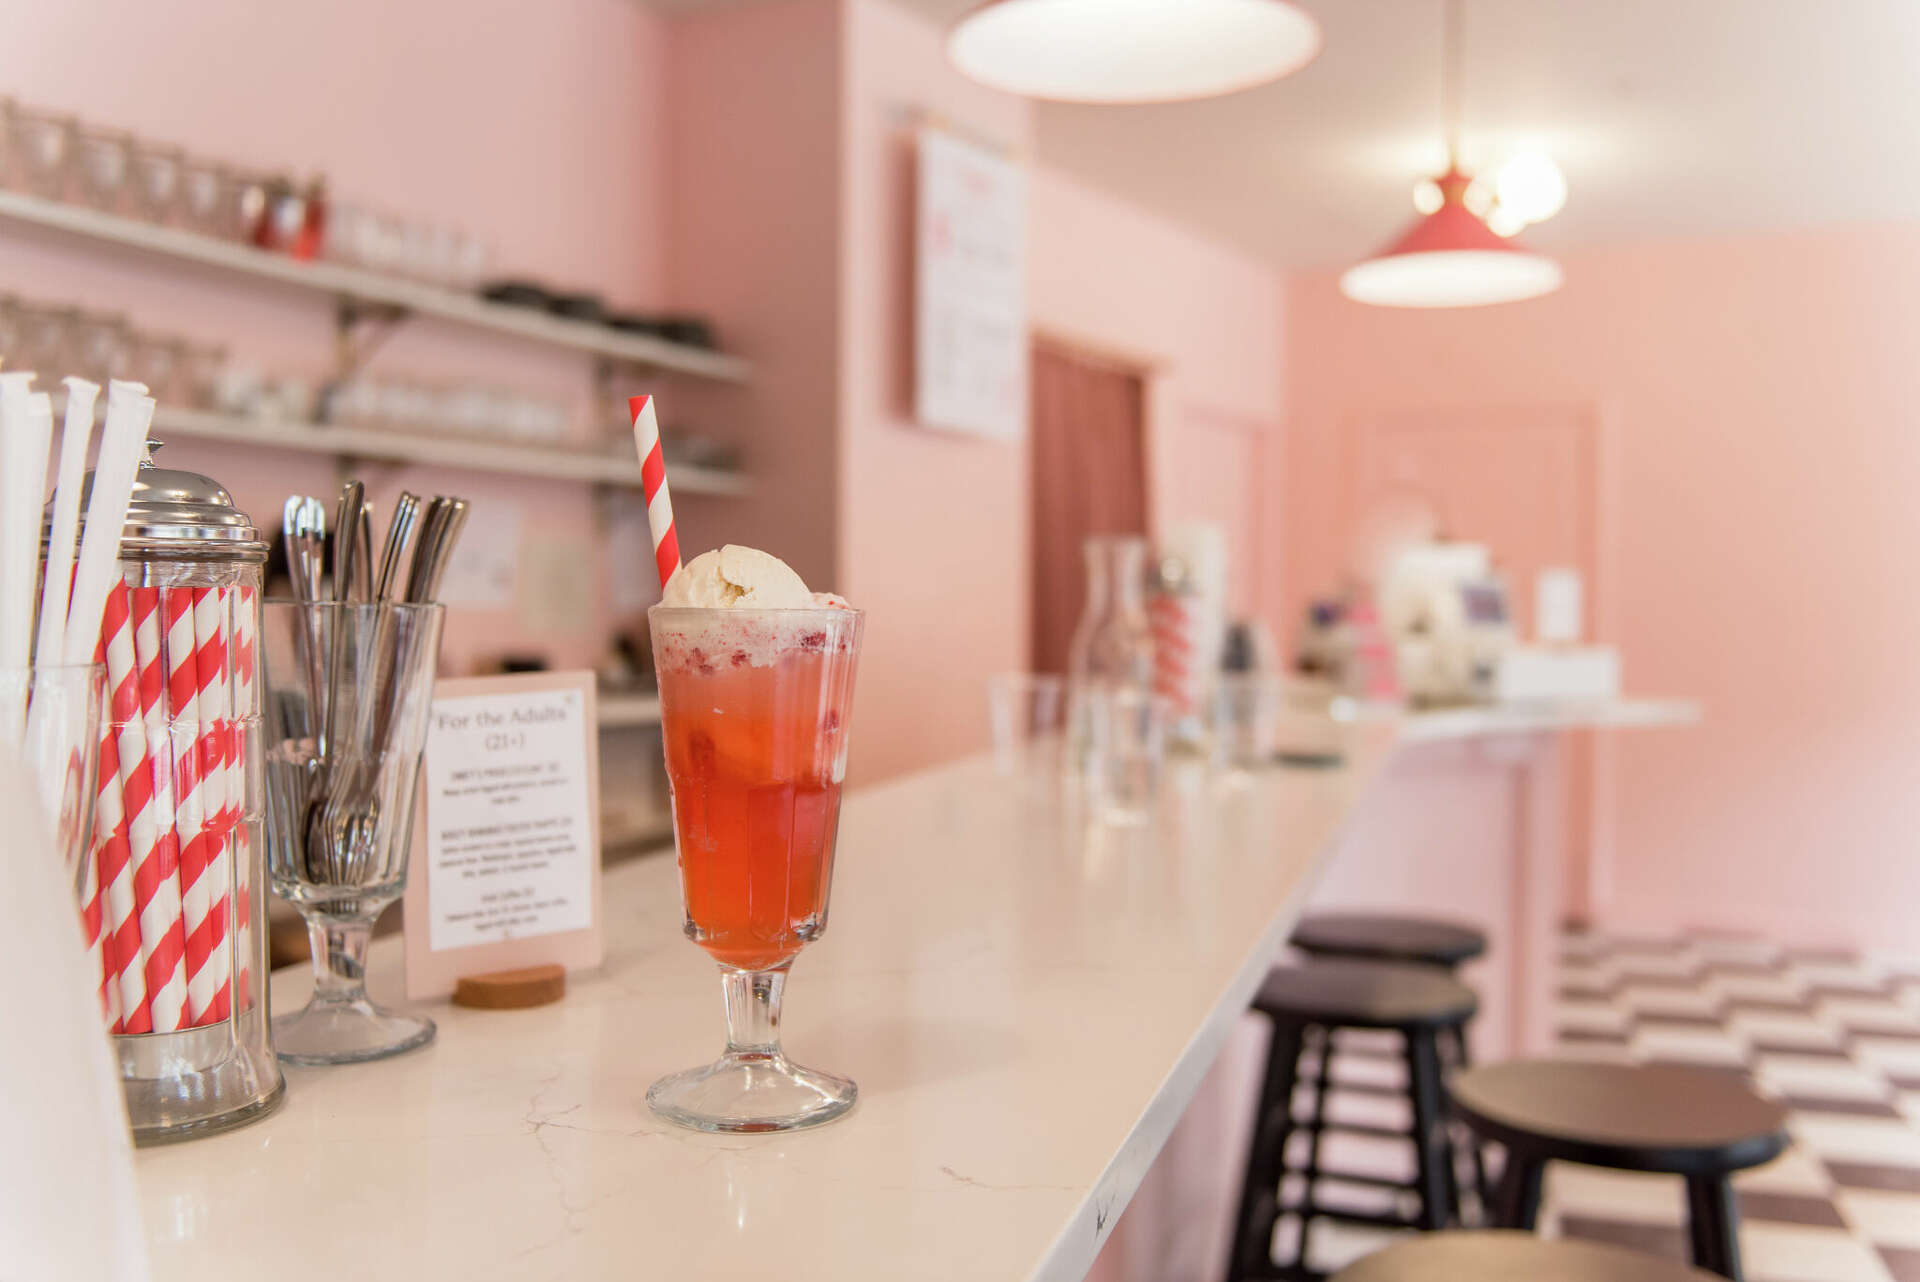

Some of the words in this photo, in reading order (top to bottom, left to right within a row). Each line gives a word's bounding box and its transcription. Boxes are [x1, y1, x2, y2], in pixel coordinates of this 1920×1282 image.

[438, 713, 469, 730] For
[475, 709, 504, 728] the
[511, 706, 567, 724] Adults
